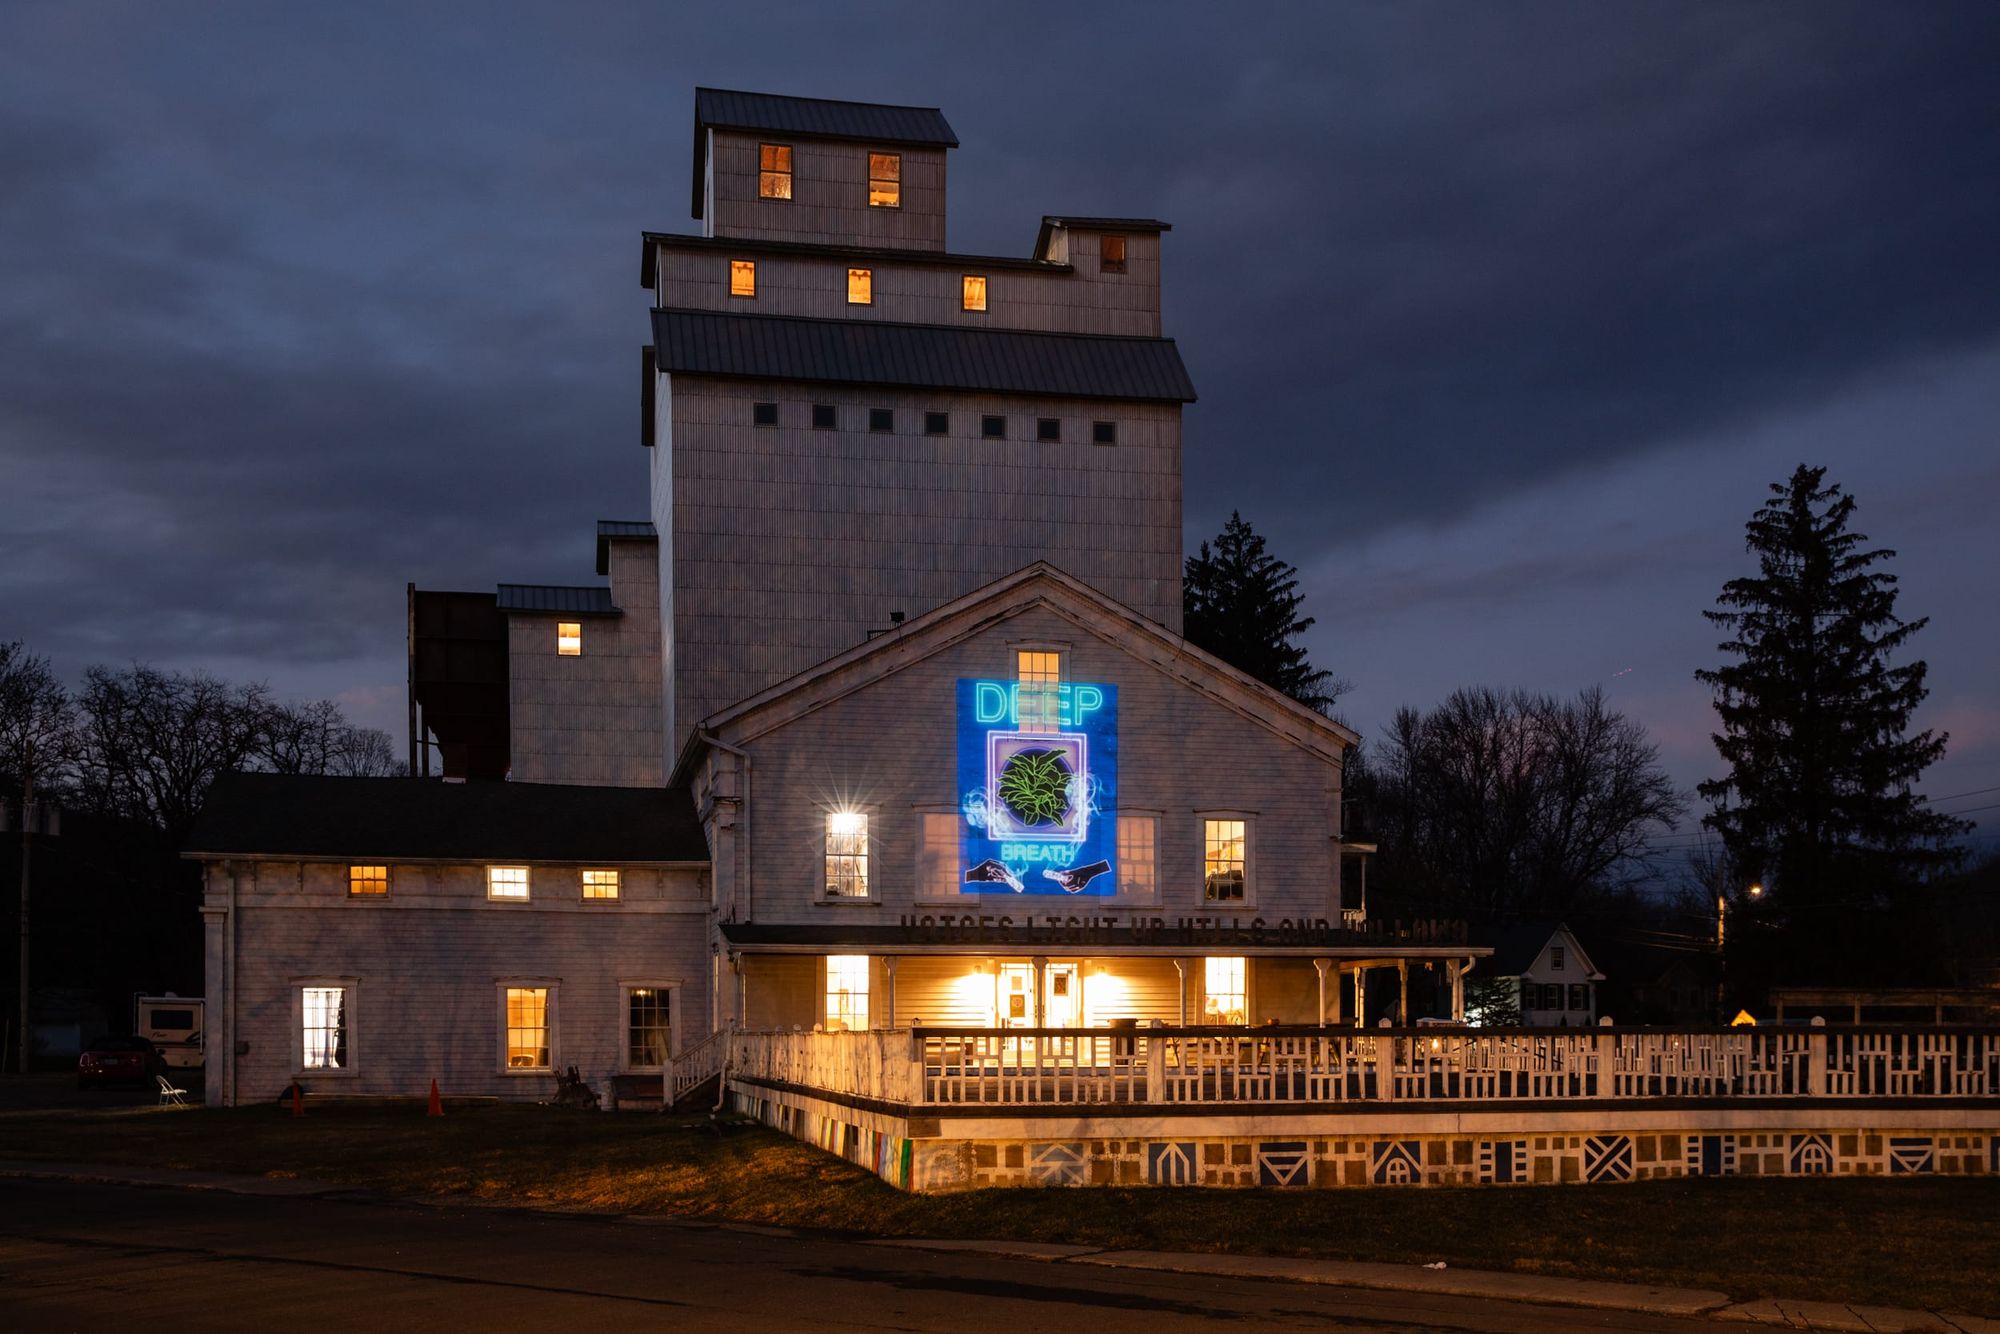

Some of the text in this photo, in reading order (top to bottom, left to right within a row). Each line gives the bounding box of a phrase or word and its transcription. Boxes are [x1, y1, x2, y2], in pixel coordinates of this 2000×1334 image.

[976, 683, 1102, 725] DEEP
[1001, 844, 1074, 861] BREATH
[1027, 917, 1118, 944] LIGHT
[1131, 917, 1165, 944] UP
[1178, 918, 1266, 945] HILLS
